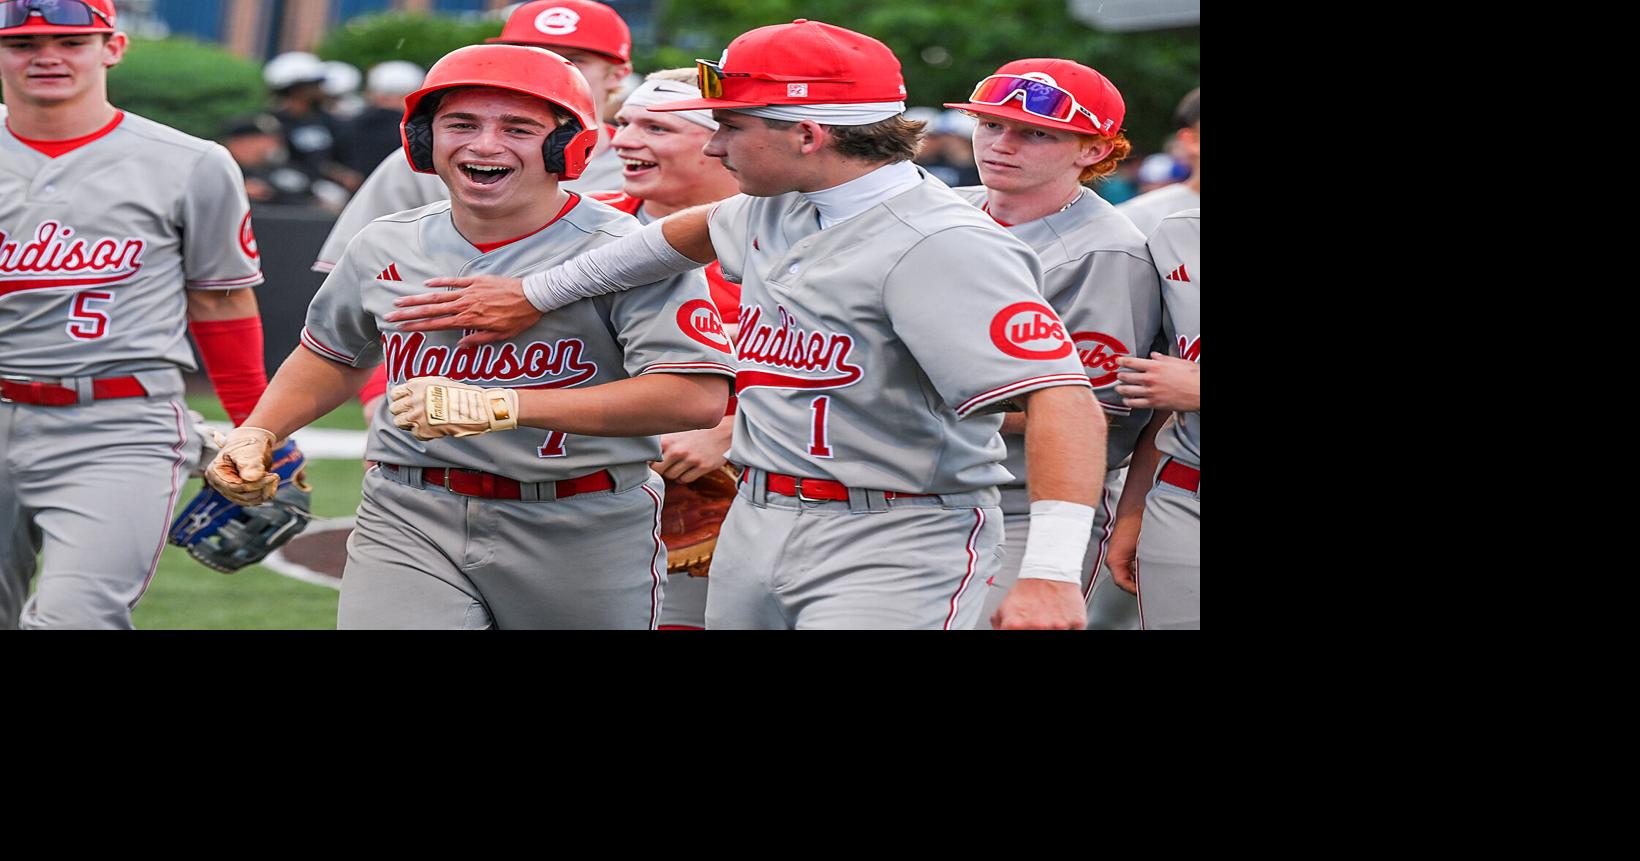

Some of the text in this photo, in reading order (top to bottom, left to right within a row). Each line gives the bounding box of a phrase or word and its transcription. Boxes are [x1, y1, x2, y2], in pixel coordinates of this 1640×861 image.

[0, 219, 147, 276] adison
[65, 291, 115, 341] 5
[675, 298, 732, 355] Cub
[737, 304, 864, 375] Madison
[989, 301, 1074, 361] Cubs
[808, 394, 834, 459] 1
